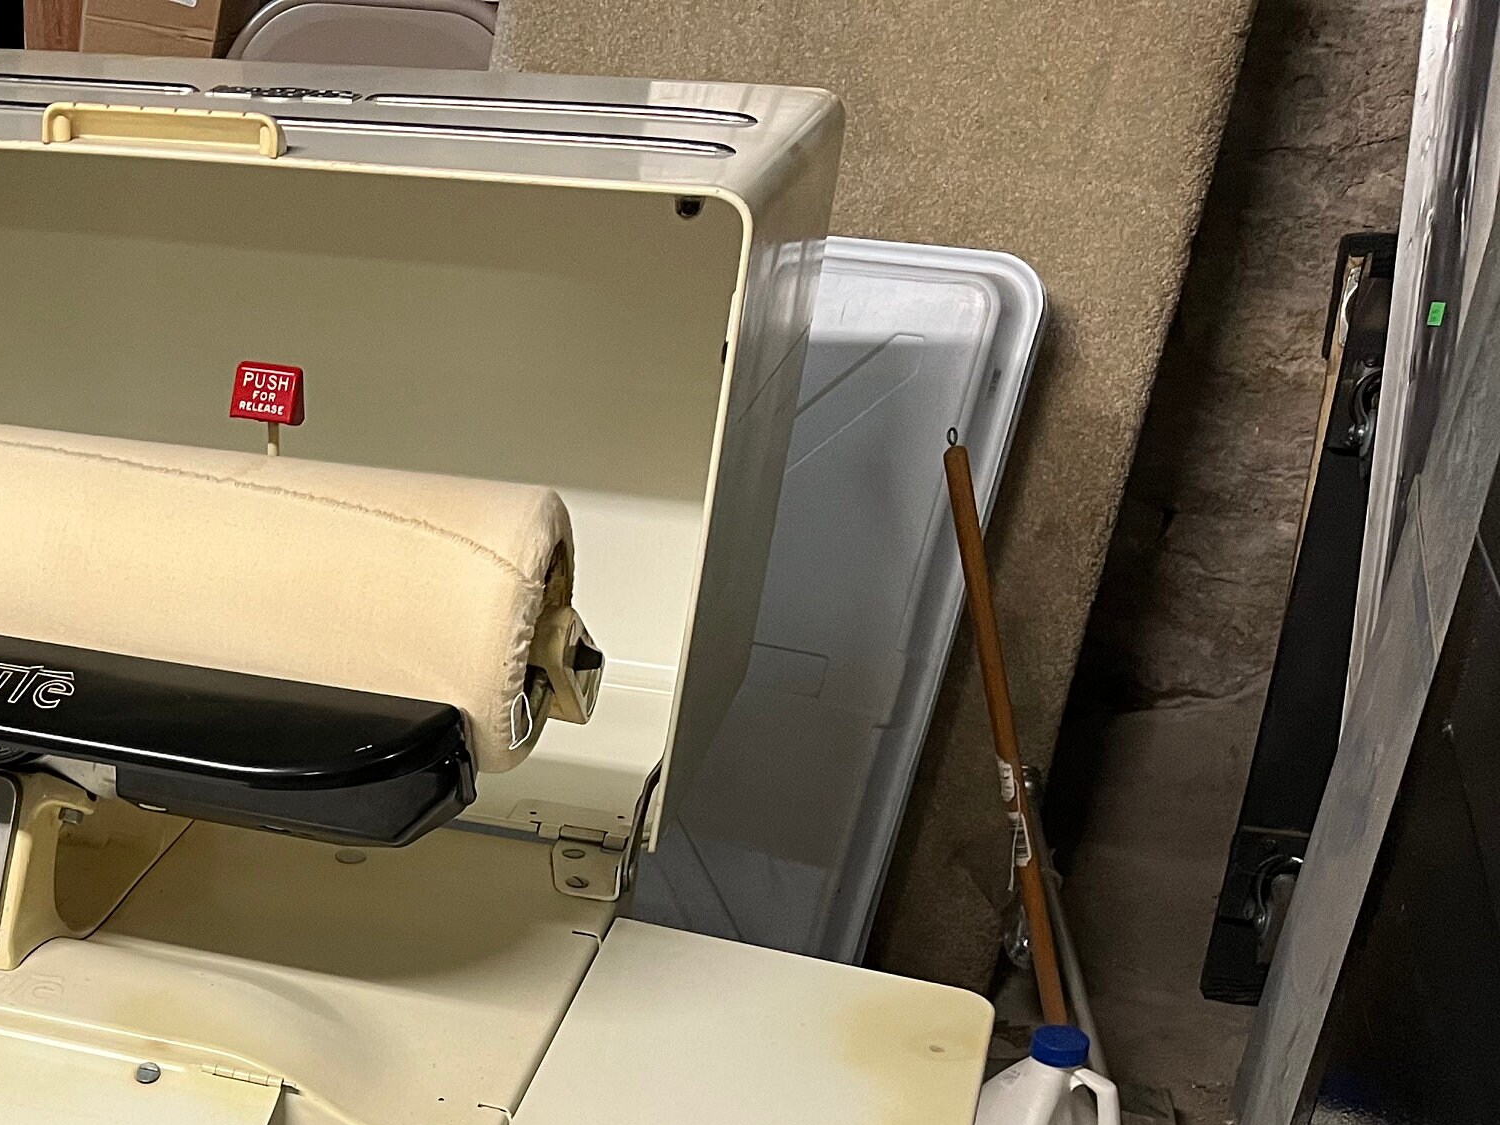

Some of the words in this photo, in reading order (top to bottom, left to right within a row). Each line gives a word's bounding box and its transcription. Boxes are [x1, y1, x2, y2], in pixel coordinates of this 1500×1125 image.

[243, 371, 289, 391] PUSH
[252, 390, 276, 402] FOR
[238, 401, 284, 415] RELEASE
